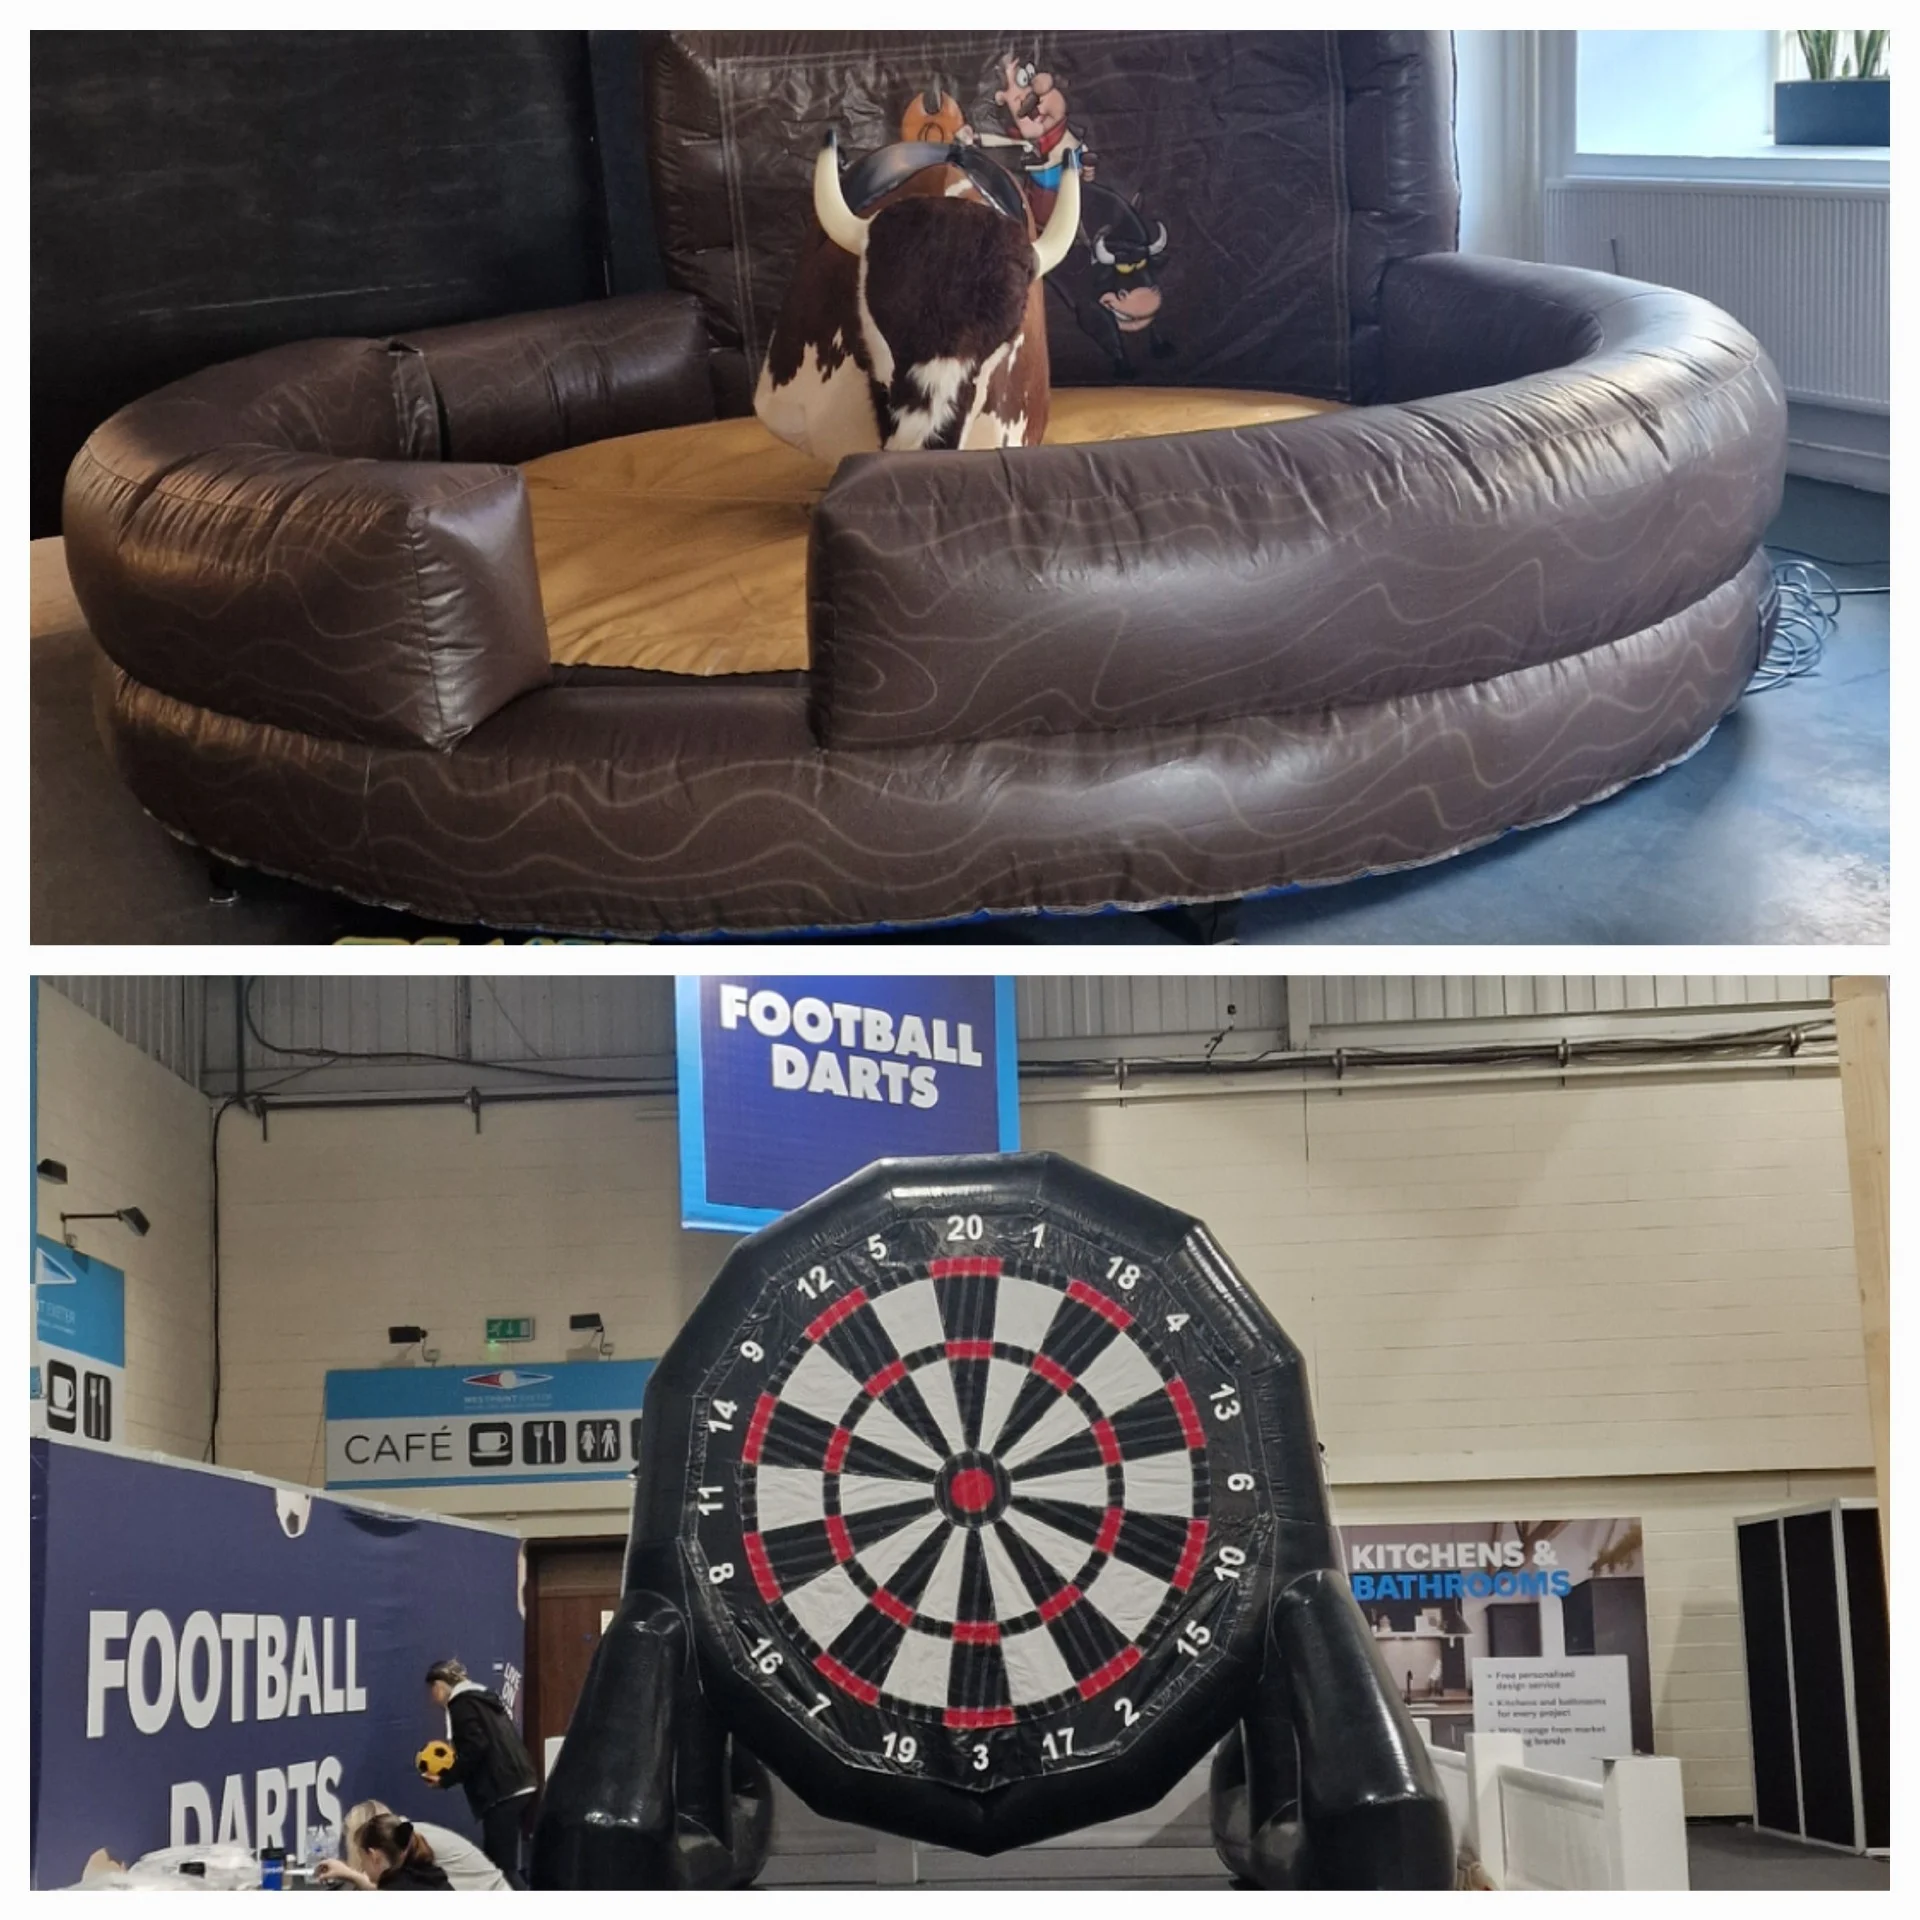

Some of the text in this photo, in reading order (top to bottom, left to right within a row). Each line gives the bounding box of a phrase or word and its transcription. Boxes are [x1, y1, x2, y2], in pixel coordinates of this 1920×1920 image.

[720, 983, 983, 1067] FOOTBALL
[771, 1043, 940, 1109] DARTS
[946, 1213, 984, 1243] 20
[1030, 1222, 1046, 1249] 1
[867, 1233, 888, 1261] 5
[796, 1265, 836, 1300] 12
[1105, 1255, 1142, 1290] 18
[1165, 1313, 1191, 1333] 4
[739, 1340, 765, 1363] 9
[706, 1399, 738, 1433] 14
[1209, 1383, 1241, 1421] 13
[344, 1425, 453, 1465] CAFÉ
[1227, 1473, 1255, 1492] 6
[697, 1485, 724, 1516] 11
[1213, 1545, 1246, 1581] 10
[1353, 1539, 1559, 1570] KITCHENS &
[708, 1562, 735, 1585] 8
[1353, 1569, 1573, 1601] BATHROOMS
[1176, 1619, 1211, 1657] 15
[750, 1638, 784, 1675] 16
[86, 1608, 367, 1739] FOOTBALL
[1496, 1670, 1576, 1681] Free personalised
[1496, 1681, 1561, 1691] design service
[807, 1692, 832, 1718] 7
[1114, 1697, 1141, 1727] 2
[1496, 1697, 1607, 1706] Kitchens and bathrooms
[1497, 1709, 1571, 1720] for every project
[1042, 1727, 1075, 1760] 17
[1523, 1726, 1550, 1735] range
[1551, 1725, 1573, 1733] from
[1574, 1724, 1606, 1733] market
[1534, 1736, 1566, 1746] brands
[882, 1732, 917, 1764] 19
[973, 1744, 989, 1771] 3
[170, 1756, 343, 1868] DARTS
